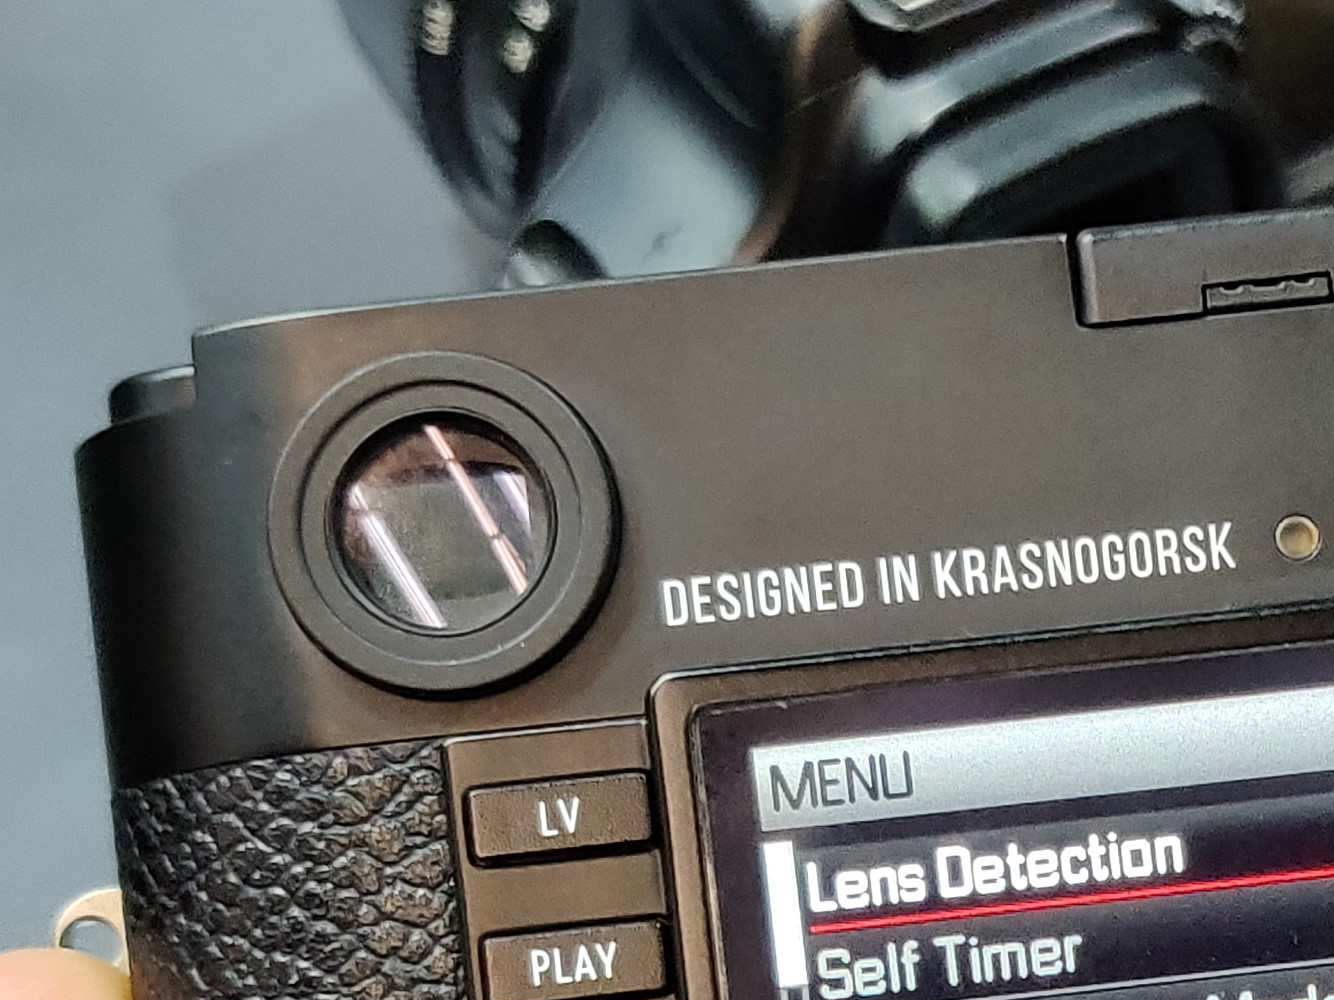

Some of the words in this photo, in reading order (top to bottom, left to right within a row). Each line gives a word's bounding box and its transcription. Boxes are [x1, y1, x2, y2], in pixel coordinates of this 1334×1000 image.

[662, 562, 864, 628] DESIGNED
[879, 555, 920, 604] IN
[932, 522, 1238, 598] KRASNOGORSK
[769, 751, 914, 812] MENU
[537, 799, 581, 837] LV
[806, 854, 924, 915] Lens
[936, 832, 1185, 900] Detection
[530, 941, 618, 986] PLAY
[818, 945, 921, 1000] Self
[935, 934, 1083, 985] Timer
